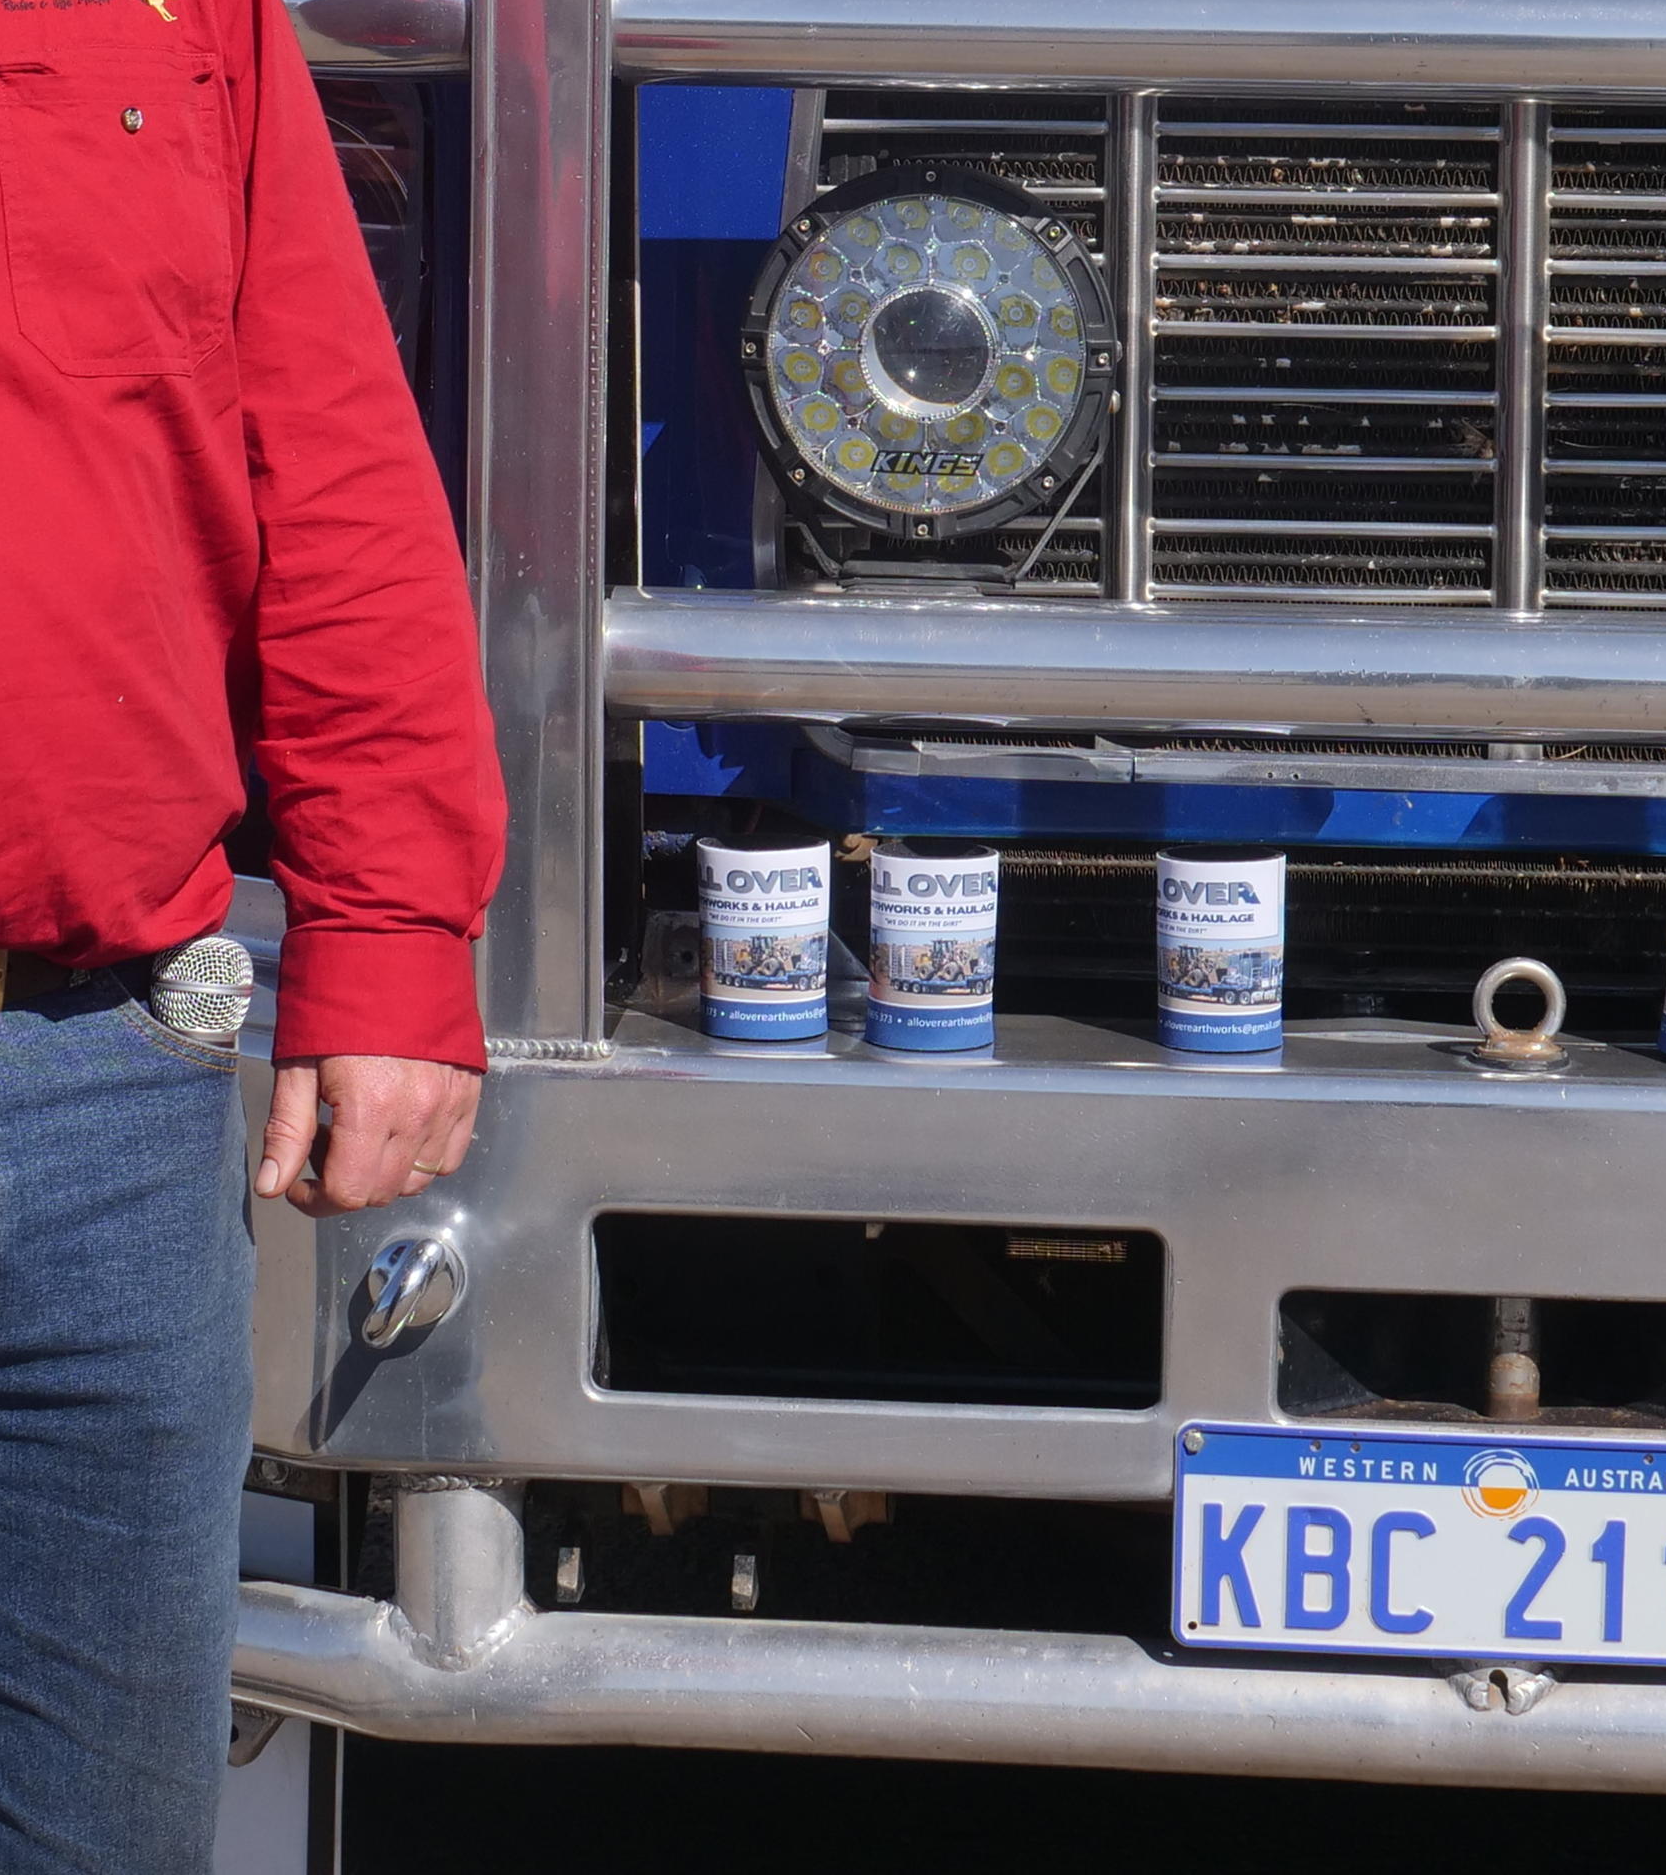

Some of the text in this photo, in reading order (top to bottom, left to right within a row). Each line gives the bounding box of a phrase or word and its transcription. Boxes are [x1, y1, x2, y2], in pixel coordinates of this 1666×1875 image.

[870, 450, 985, 476] KINGS
[726, 866, 824, 895] OVER
[907, 870, 997, 899] OVER
[1162, 877, 1261, 906] OVER
[764, 897, 820, 912] HAULAGE
[1179, 911, 1189, 922] &
[1190, 912, 1255, 923] HAULAGE
[1297, 1455, 1439, 1482] WESTERN
[1199, 1502, 1438, 1635] KBC
